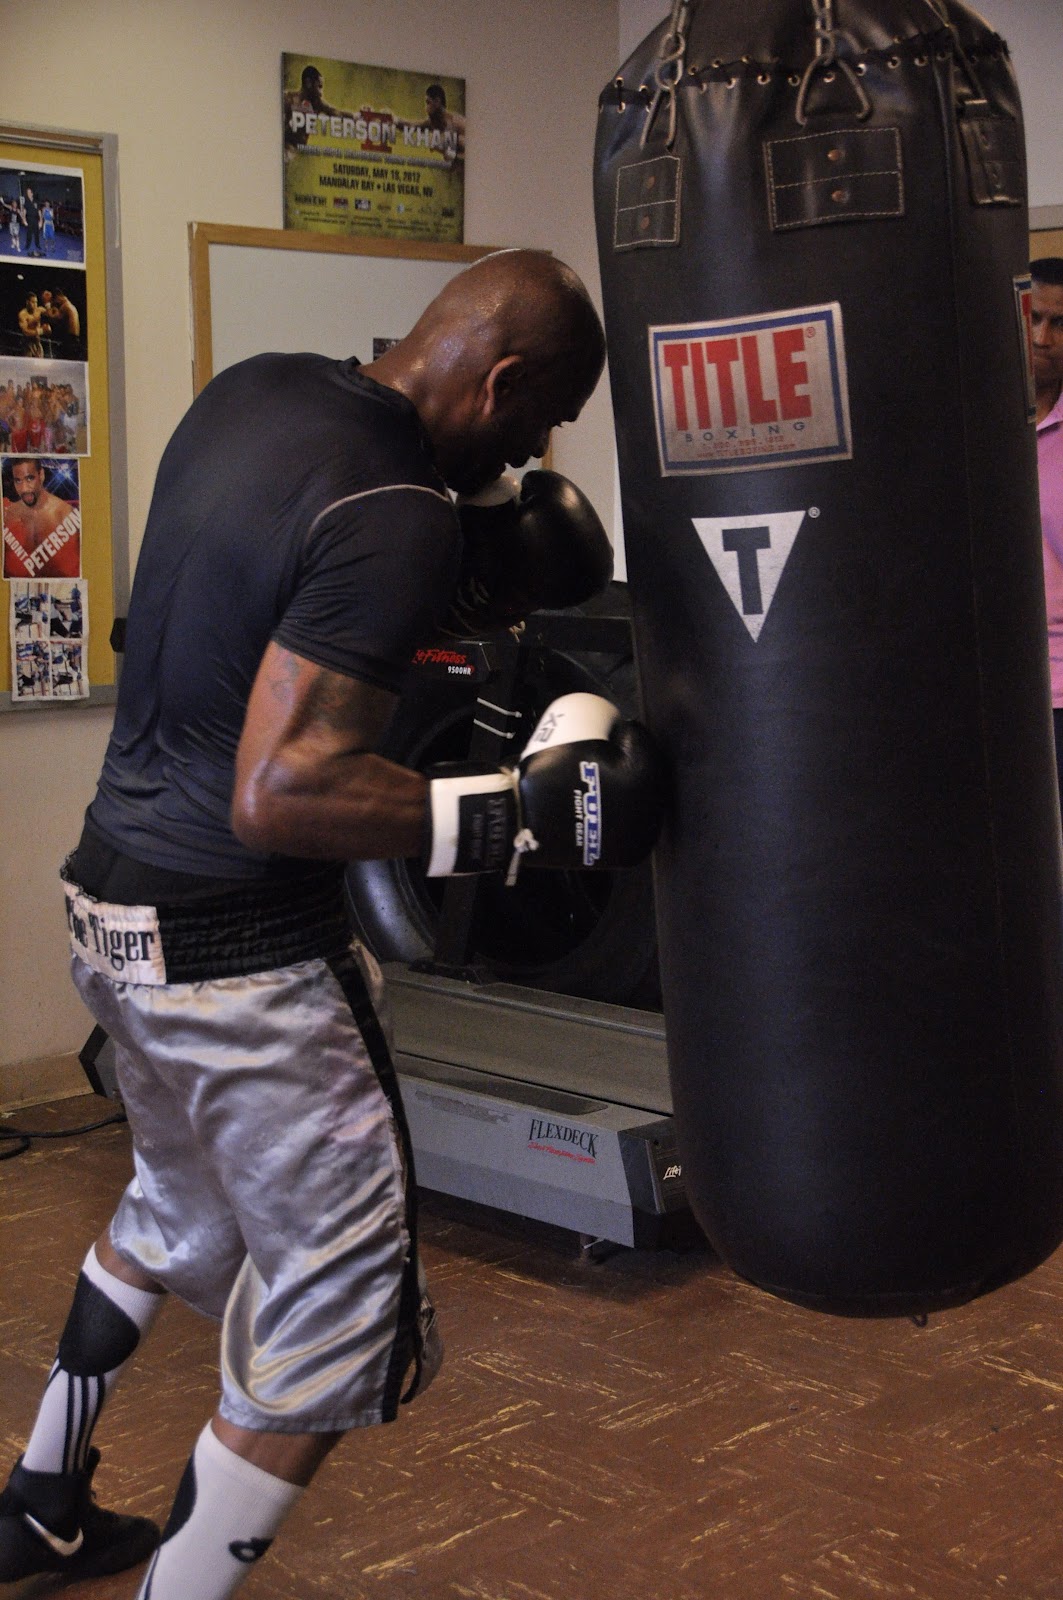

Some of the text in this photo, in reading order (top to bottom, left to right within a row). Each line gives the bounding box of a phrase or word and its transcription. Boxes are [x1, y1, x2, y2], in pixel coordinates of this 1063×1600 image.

[291, 111, 458, 149] PETERSON KHAN
[319, 175, 359, 190] MANDALAY
[361, 180, 374, 192] BAY
[383, 183, 396, 193] LAS
[333, 163, 371, 180] SATURDAY,
[373, 167, 388, 178] MAY
[403, 171, 421, 183] 2012
[664, 328, 812, 431] TITLE
[684, 421, 805, 443] BOXING
[3, 526, 28, 561] AMONT
[24, 507, 80, 577] PETERSON
[447, 666, 472, 676] 9500HR
[573, 789, 583, 847] FIGHT GEAR
[579, 761, 601, 866] FUEL
[88, 912, 155, 971] Tiger
[529, 1118, 599, 1159] FLEXDECK
